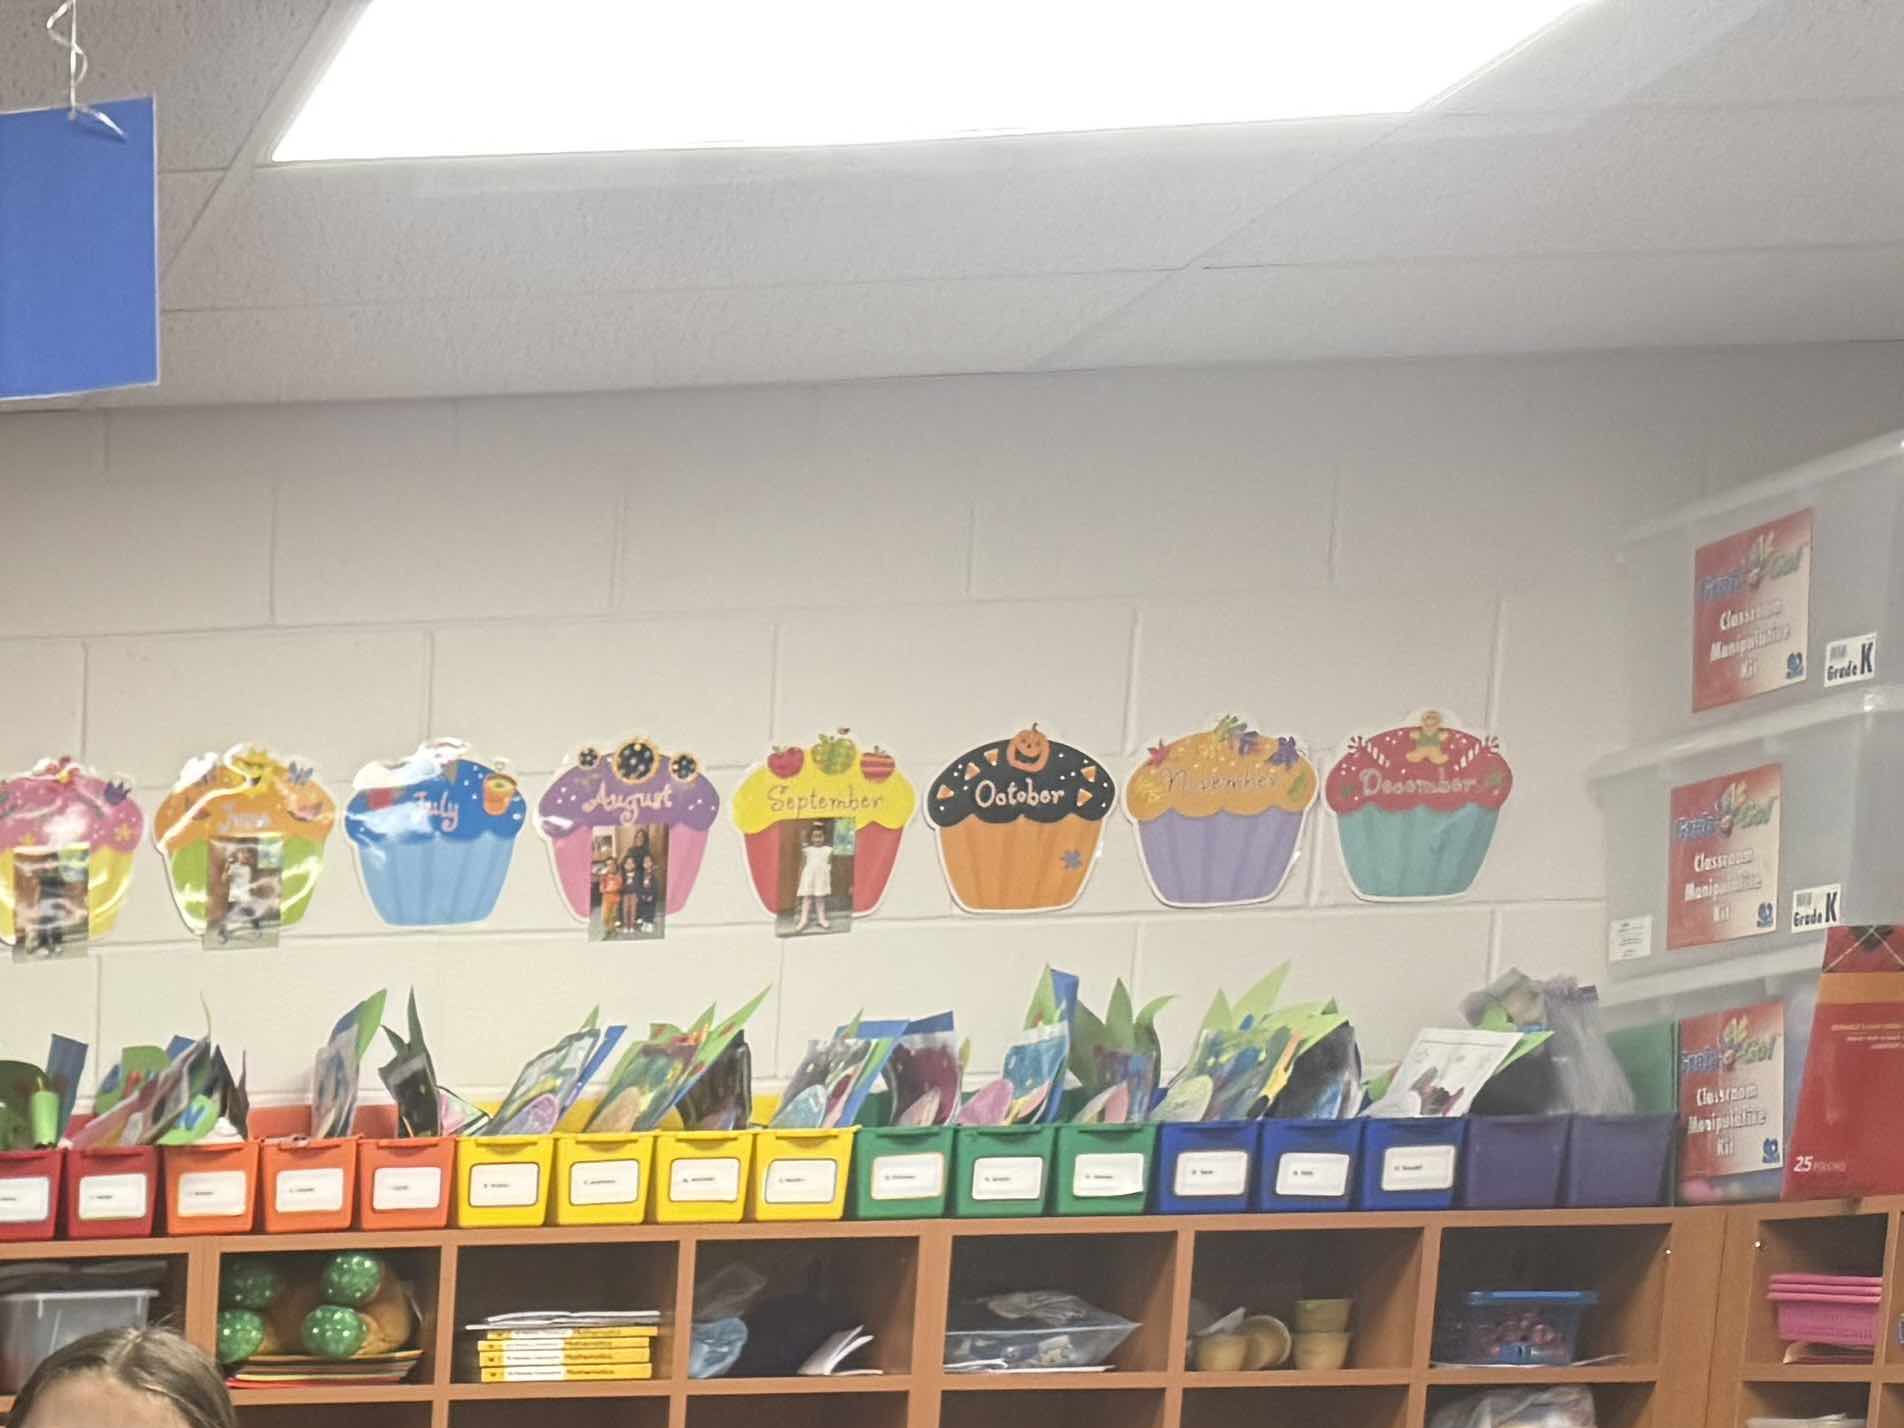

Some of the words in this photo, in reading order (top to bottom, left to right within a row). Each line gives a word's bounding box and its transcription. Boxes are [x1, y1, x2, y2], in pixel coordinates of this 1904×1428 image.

[1827, 661, 1857, 681] Grade
[1860, 642, 1874, 674] K
[582, 782, 672, 824] August
[767, 785, 884, 816] September
[975, 779, 1064, 807] October
[413, 791, 459, 832] July
[1793, 910, 1822, 927] Grade
[1825, 892, 1837, 923] K
[1793, 1155, 1813, 1172] 25
